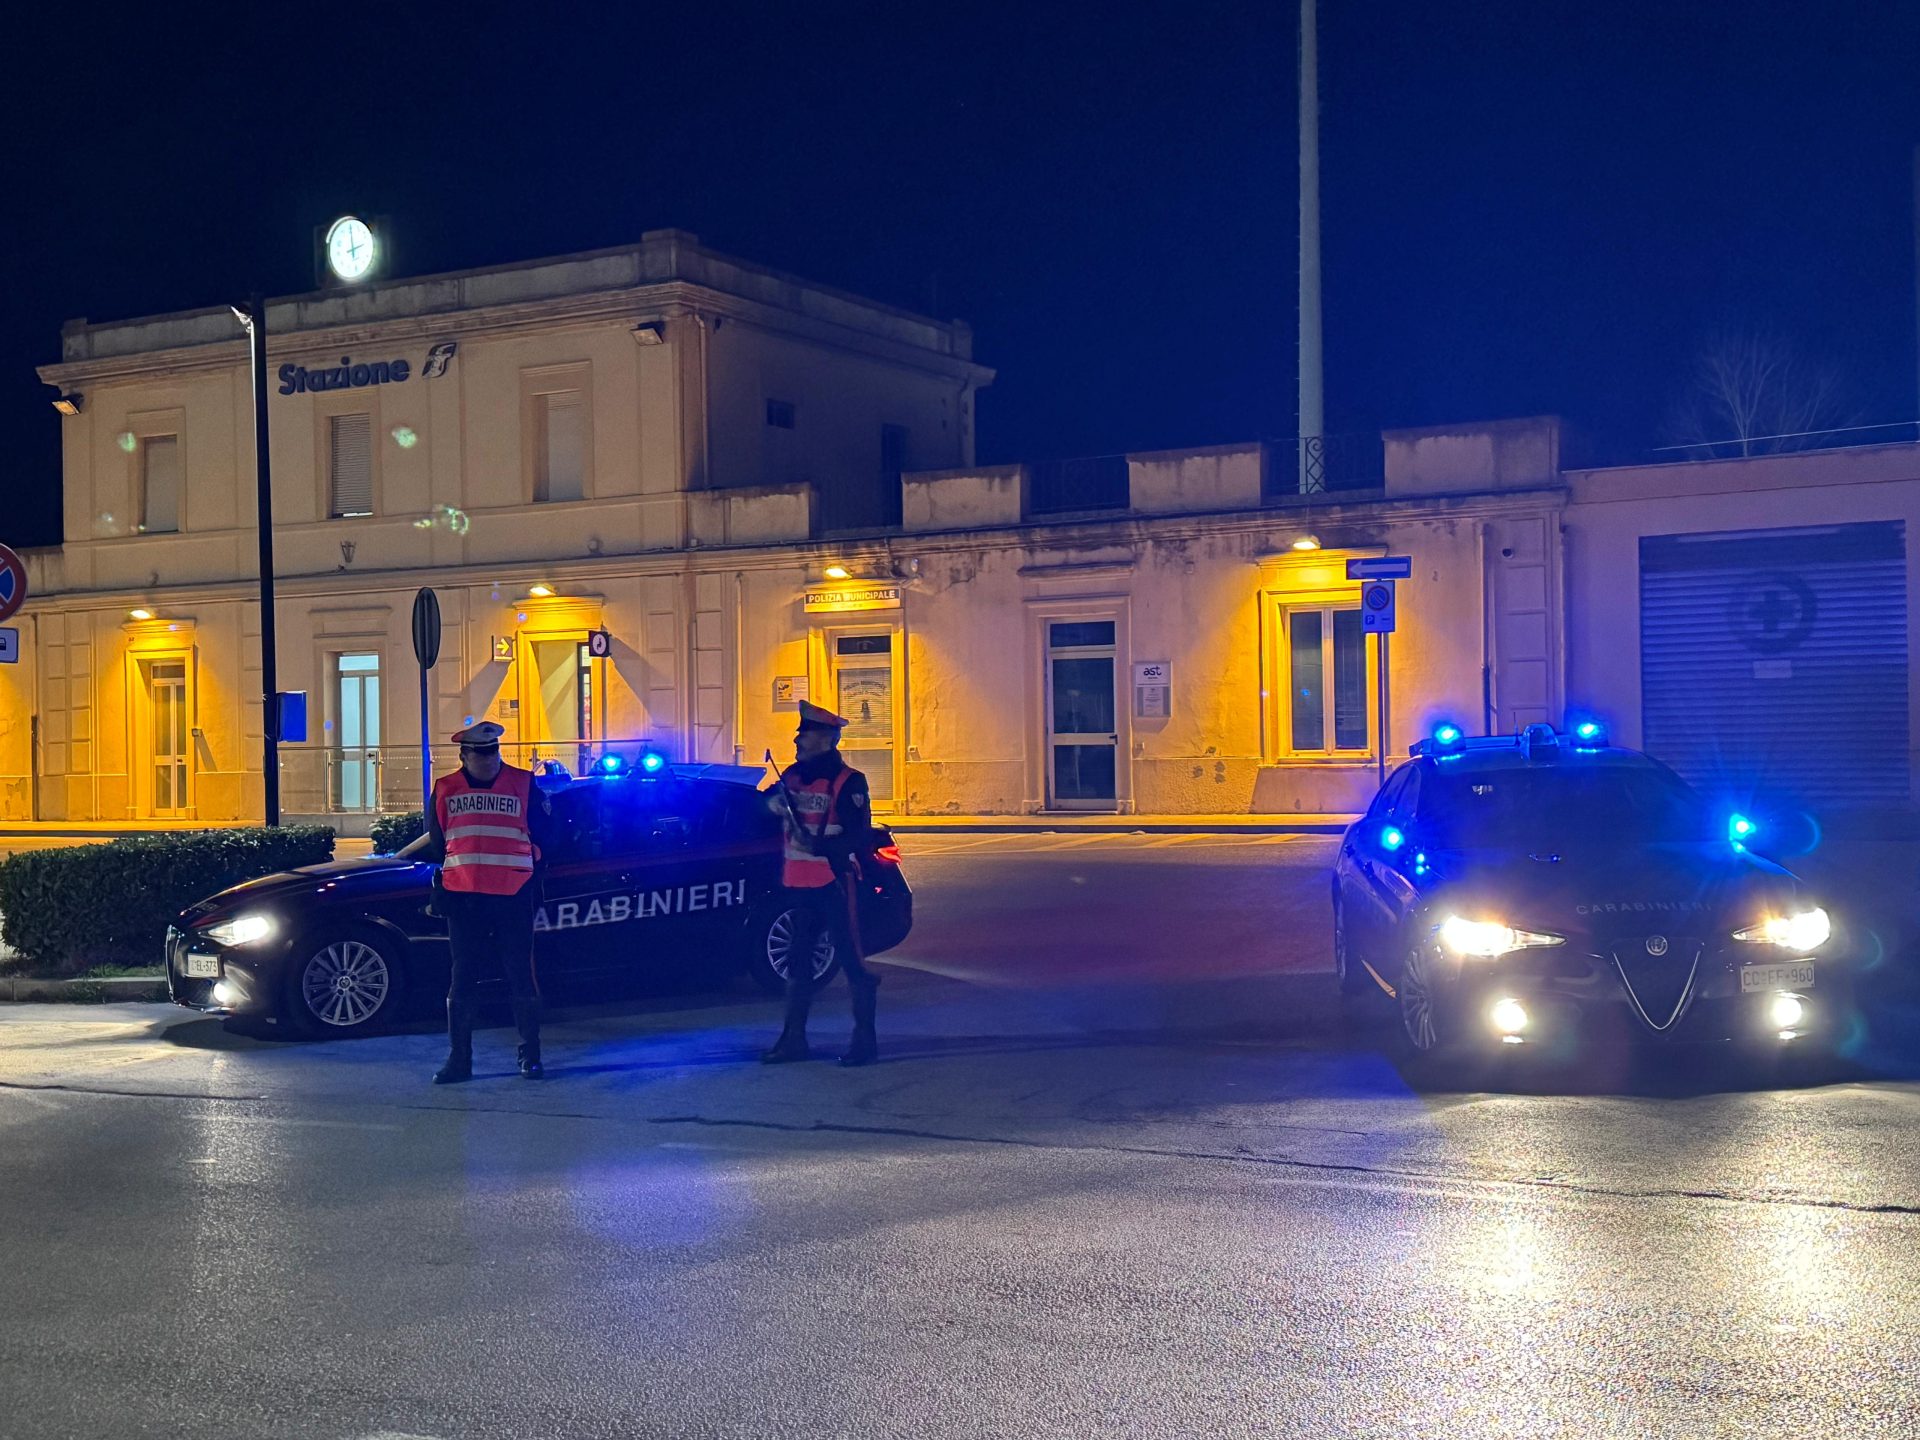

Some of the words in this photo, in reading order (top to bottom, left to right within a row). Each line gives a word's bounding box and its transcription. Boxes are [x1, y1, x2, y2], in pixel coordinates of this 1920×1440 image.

[278, 356, 410, 395] Stazione
[808, 593, 842, 604] POLIZIA
[843, 590, 895, 602] MUNICIPALE
[1143, 665, 1162, 676] ast
[448, 795, 517, 814] CARABINIERI
[533, 879, 746, 931] ARABINIERI
[1576, 902, 1712, 915] CARABINIERI
